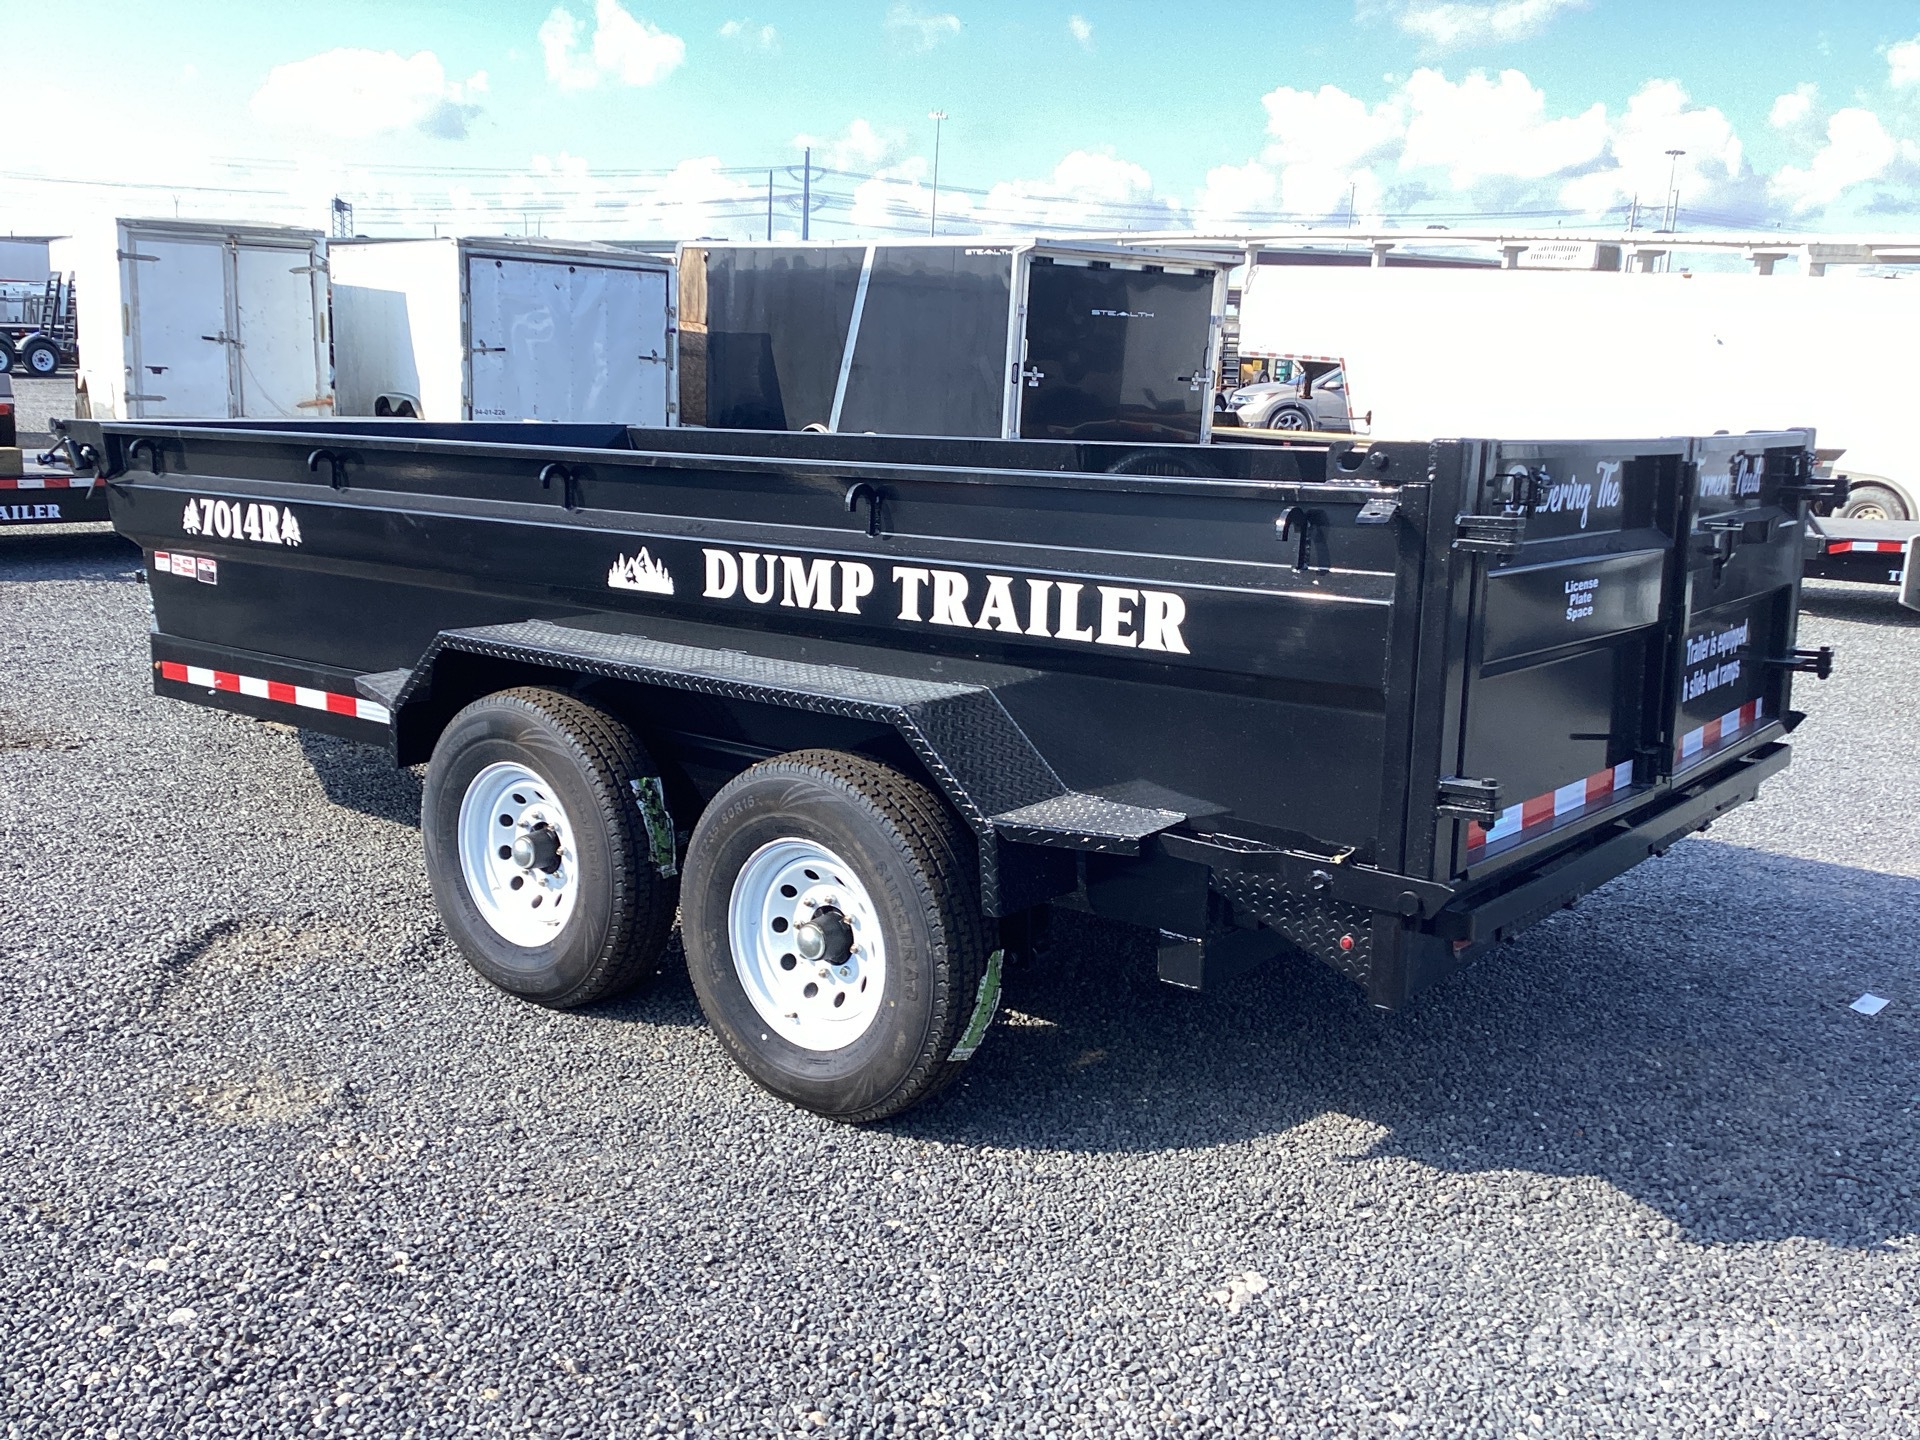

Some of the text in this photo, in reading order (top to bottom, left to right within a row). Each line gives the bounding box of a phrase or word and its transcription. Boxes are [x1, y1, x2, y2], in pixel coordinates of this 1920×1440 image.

[1091, 309, 1154, 318] STEALTH
[1597, 460, 1621, 508] The
[200, 498, 283, 544] 7014R
[702, 548, 1191, 655] DUMP TRAILER
[1564, 578, 1599, 594] License
[1569, 592, 1593, 607] Plate
[1566, 606, 1594, 622] Space
[1686, 617, 1748, 666] Trailer is equipped
[1689, 668, 1706, 700] slide
[1706, 663, 1719, 692] out
[1719, 659, 1741, 687] ramps
